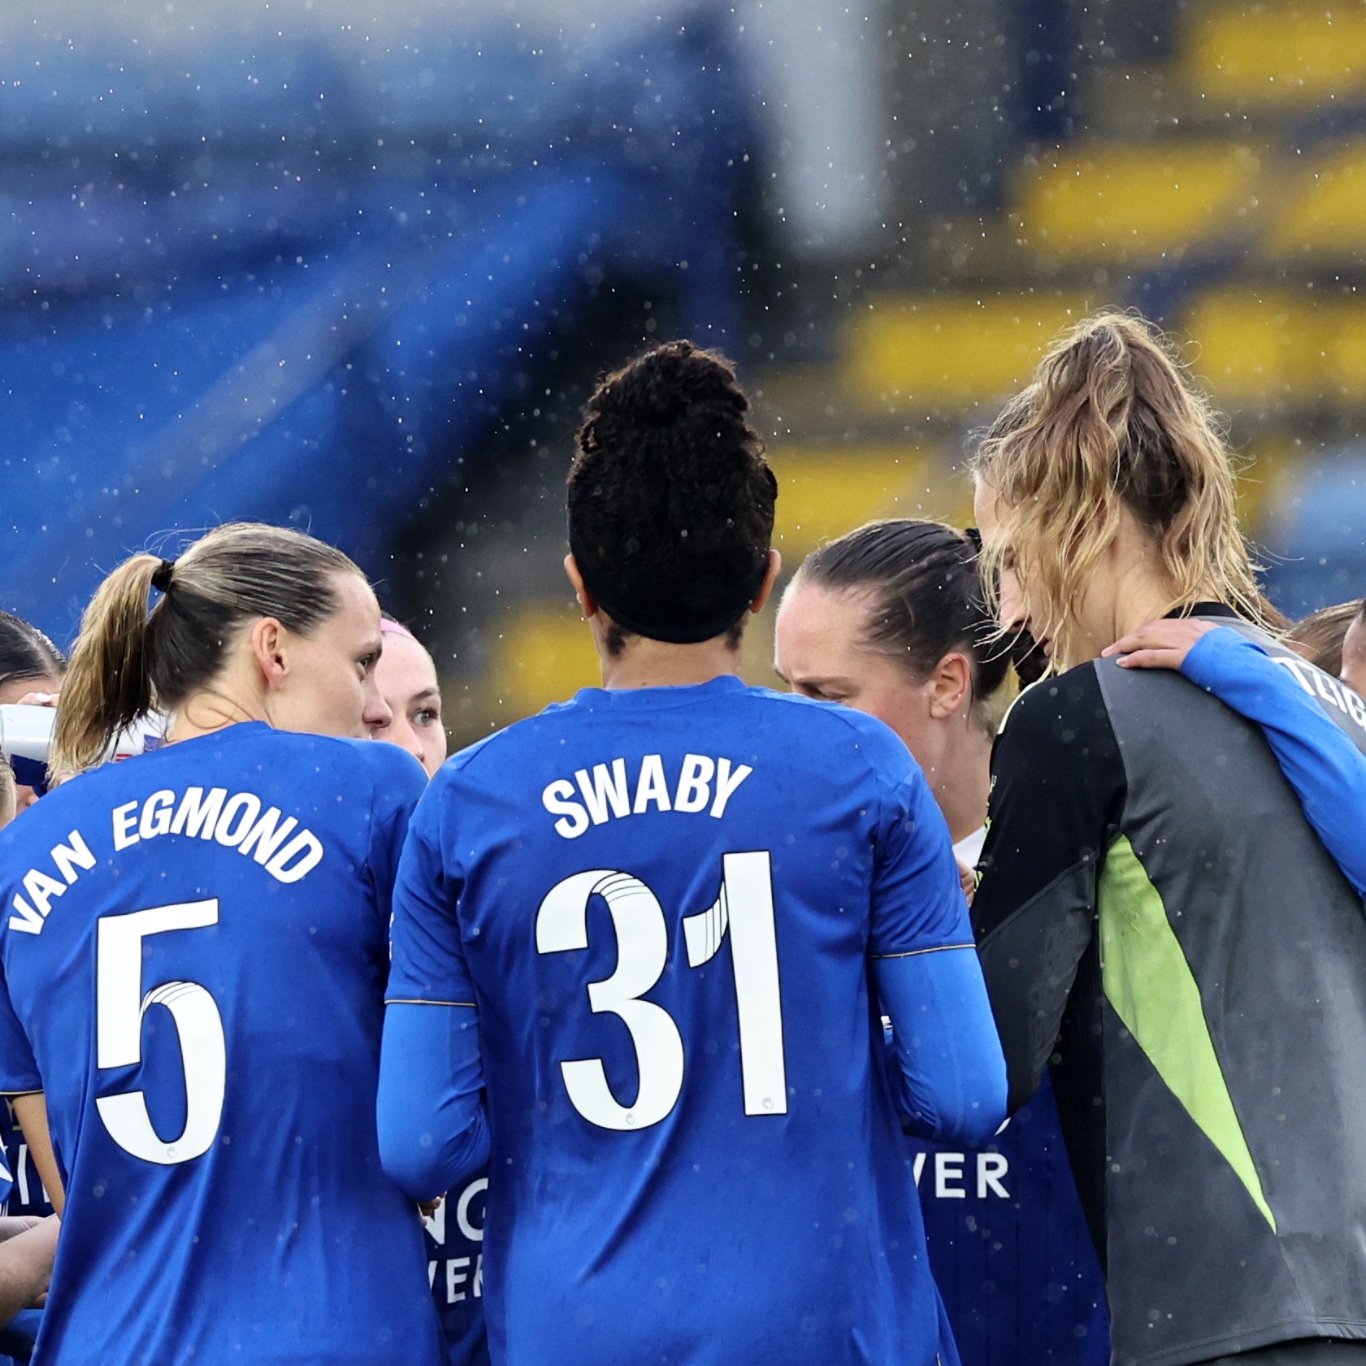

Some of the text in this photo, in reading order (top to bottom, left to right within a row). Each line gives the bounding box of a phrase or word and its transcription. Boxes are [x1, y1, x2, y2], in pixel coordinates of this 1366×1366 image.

[8, 786, 324, 935] VAN EGMOND
[541, 753, 753, 840] SWABY
[95, 897, 227, 1166] 5
[535, 850, 788, 1132] 31
